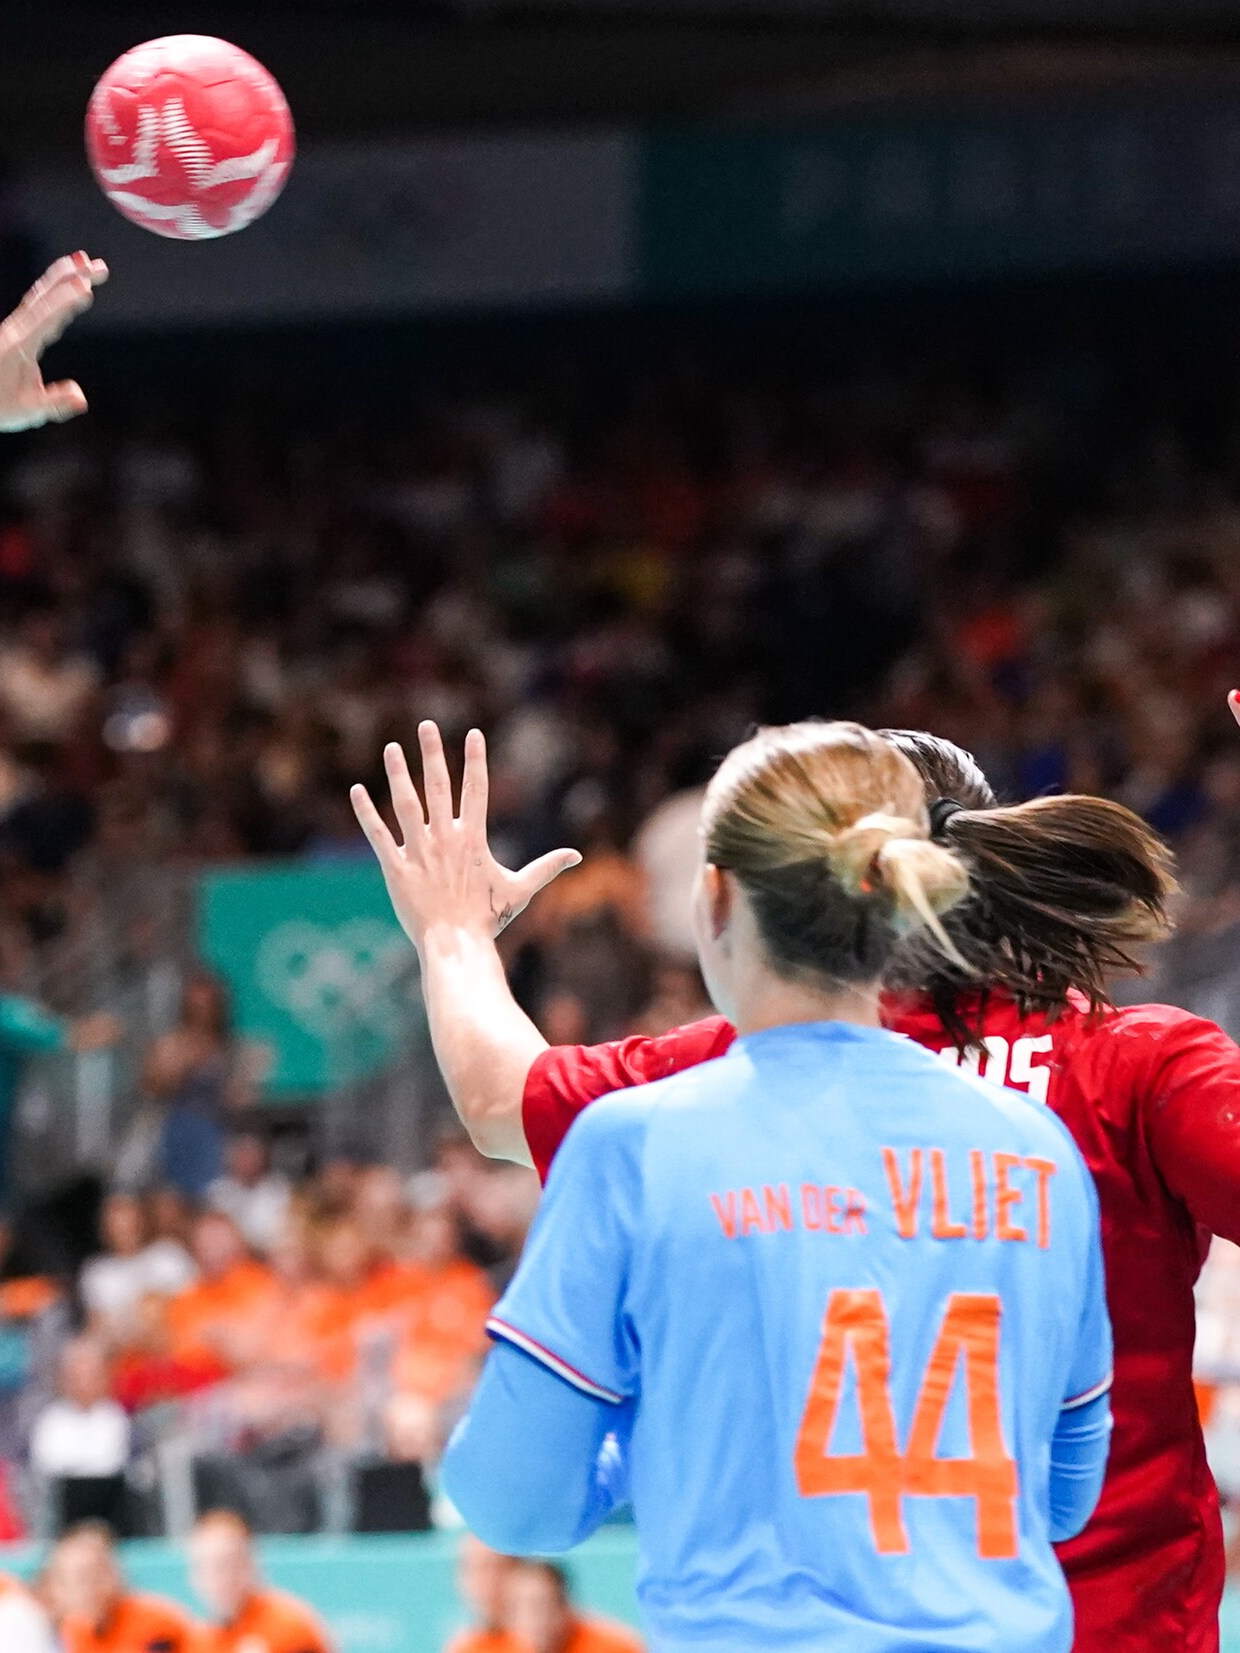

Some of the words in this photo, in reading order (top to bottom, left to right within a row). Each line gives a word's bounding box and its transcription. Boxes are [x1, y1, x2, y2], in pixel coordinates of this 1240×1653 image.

[711, 1183, 794, 1240] VAN
[800, 1183, 869, 1236] DER
[880, 1147, 1057, 1250] VLIET
[793, 1288, 1021, 1560] 44
